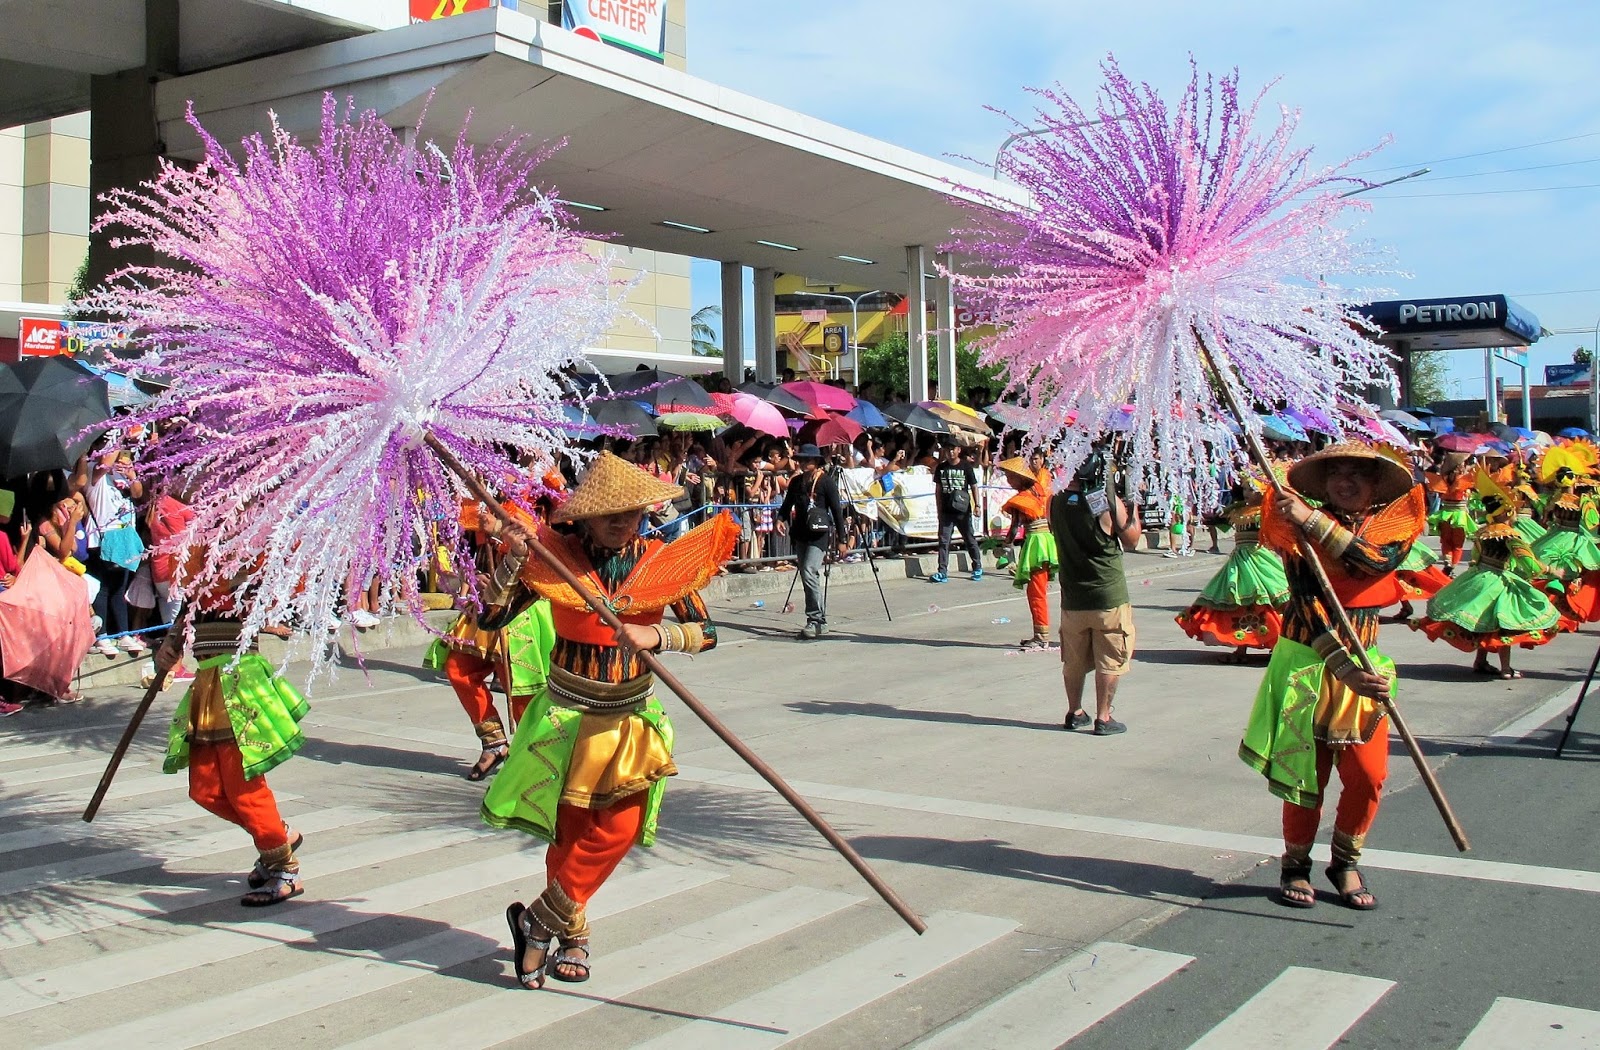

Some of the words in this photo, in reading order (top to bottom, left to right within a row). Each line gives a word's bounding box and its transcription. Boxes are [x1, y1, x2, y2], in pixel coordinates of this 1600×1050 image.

[588, 0, 647, 35] CENTER
[1400, 302, 1497, 324] PETRON
[26, 325, 57, 344] ACE
[830, 336, 838, 349] B
[24, 342, 55, 350] Hardware
